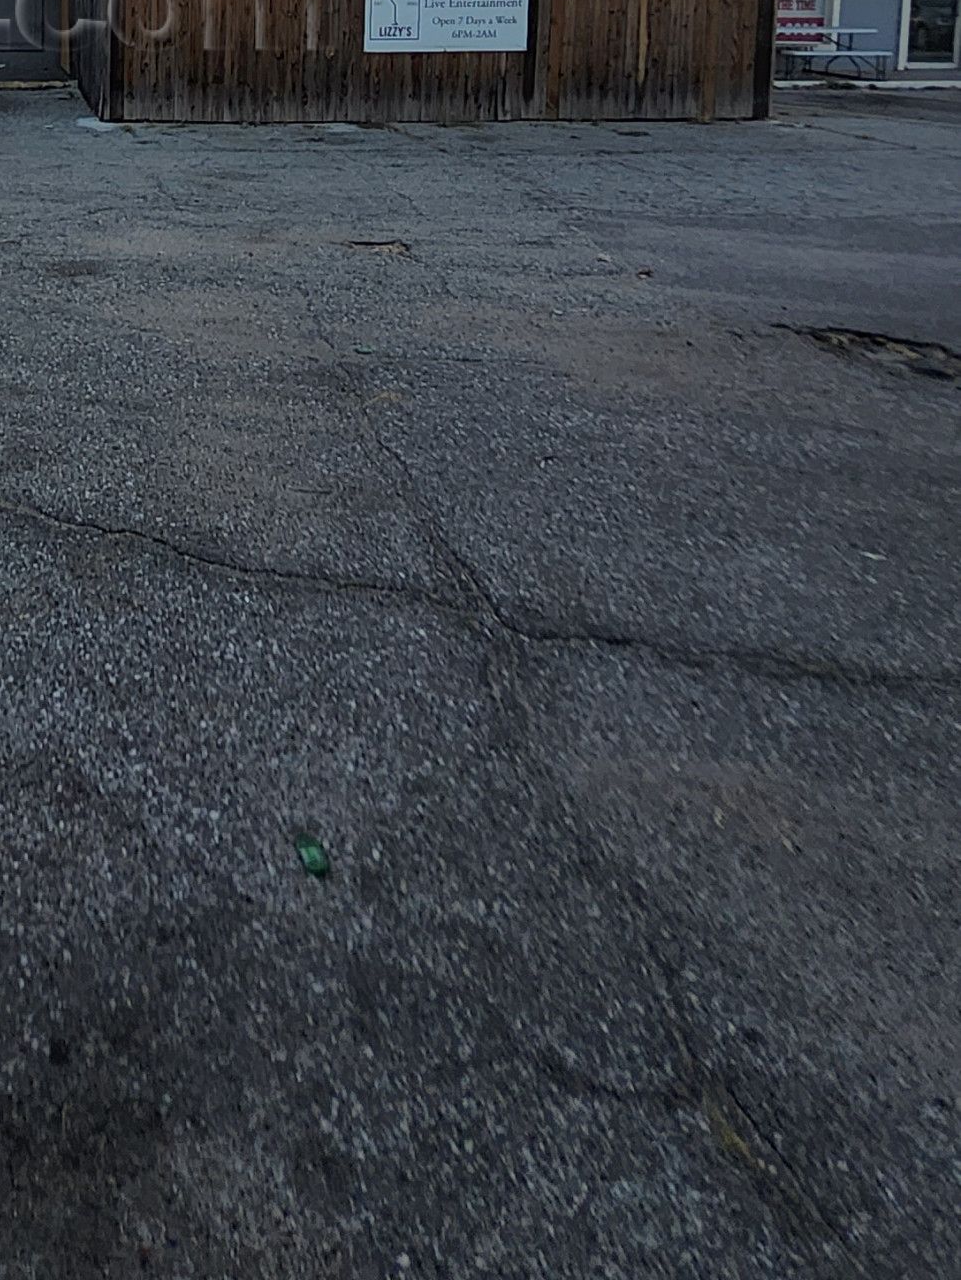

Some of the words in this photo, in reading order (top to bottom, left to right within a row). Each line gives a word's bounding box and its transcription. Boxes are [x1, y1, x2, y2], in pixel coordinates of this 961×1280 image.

[432, 16, 455, 27] Open
[465, 15, 486, 26] Days
[495, 15, 517, 25] Week
[379, 26, 412, 37] LIZZY'S
[451, 29, 497, 39] 6PM-2AM
